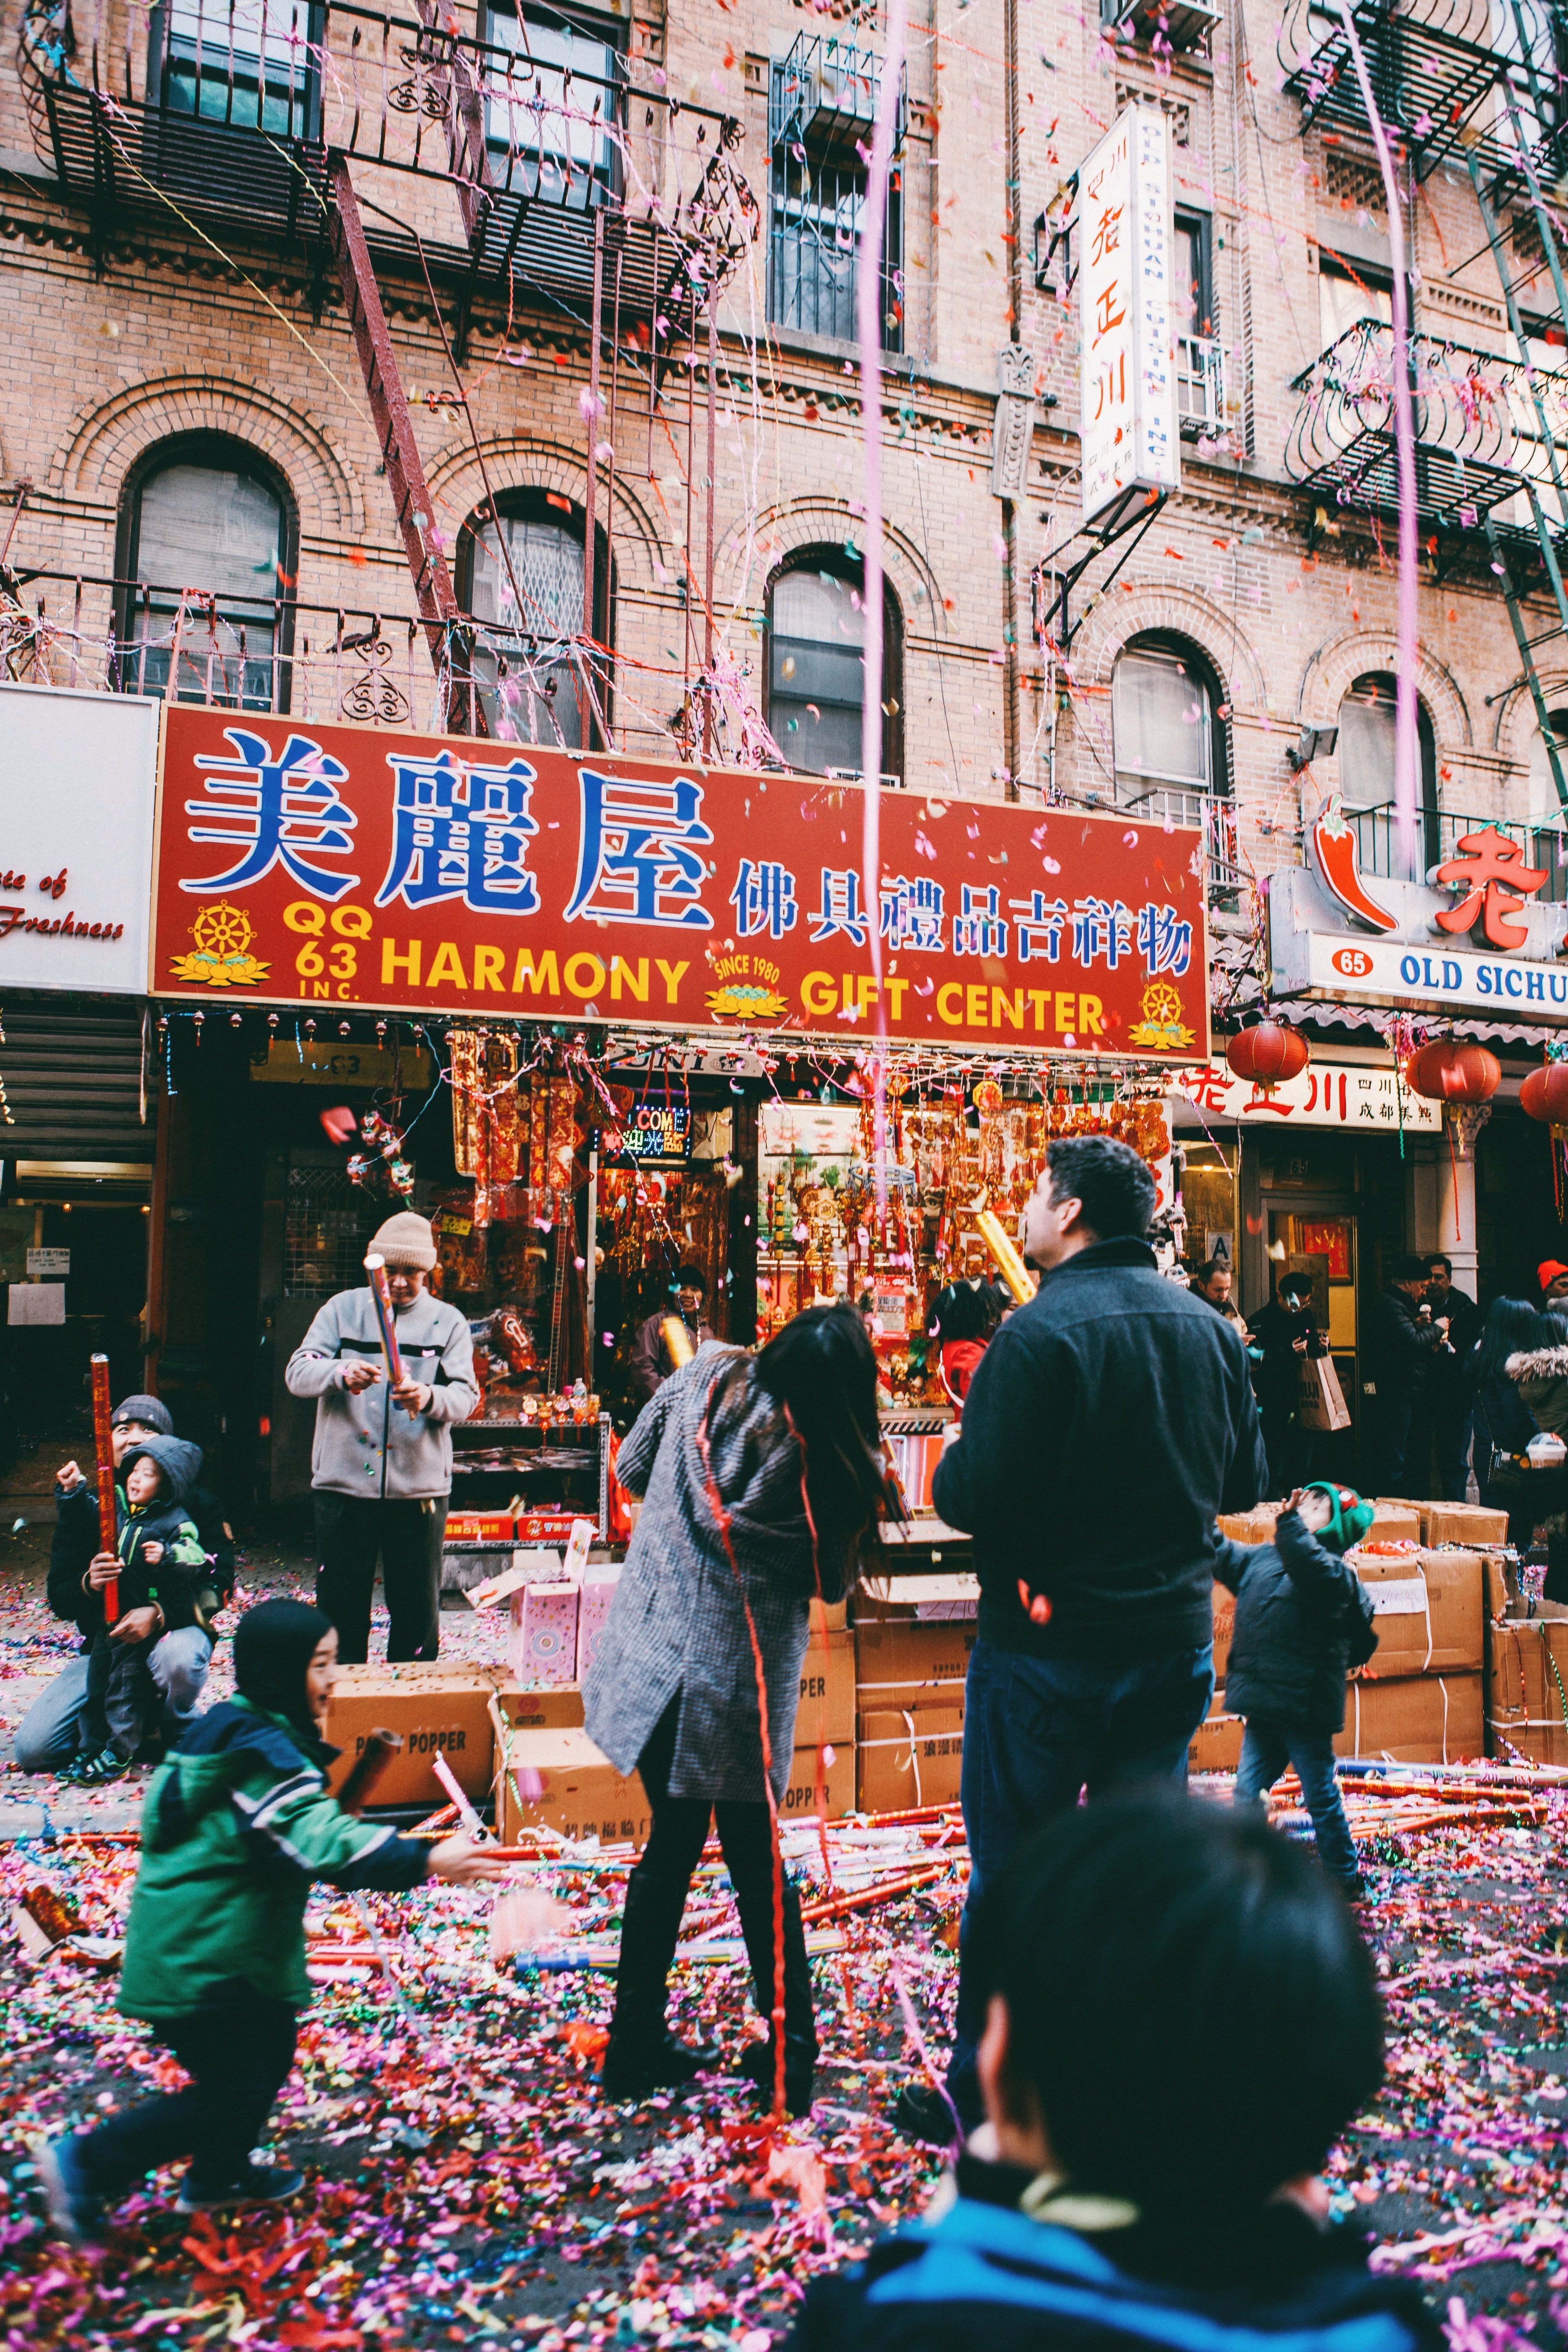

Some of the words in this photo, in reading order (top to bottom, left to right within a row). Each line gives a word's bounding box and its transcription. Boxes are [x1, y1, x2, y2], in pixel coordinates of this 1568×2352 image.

[178, 727, 714, 930] 美麗屋
[730, 858, 1192, 977] 佛具禮品吉祥物
[0, 870, 26, 889] te
[39, 868, 67, 899] of
[1434, 824, 1549, 949] 老
[0, 905, 124, 939] Freshness
[283, 901, 373, 941] QQ
[295, 941, 358, 980] 63
[714, 954, 749, 980] SINCE
[753, 956, 780, 985] 1980
[1340, 951, 1365, 974] 65
[1400, 955, 1462, 990] OLD
[1477, 965, 1568, 1003] SICHU
[299, 980, 360, 1000] INC.
[381, 937, 691, 1004] HARMONY
[800, 970, 909, 1021] GIFT
[936, 982, 1104, 1035] CENTER
[330, 1054, 361, 1075] 63
[1212, 1236, 1229, 1260] A
[409, 1730, 466, 1754] POPPER
